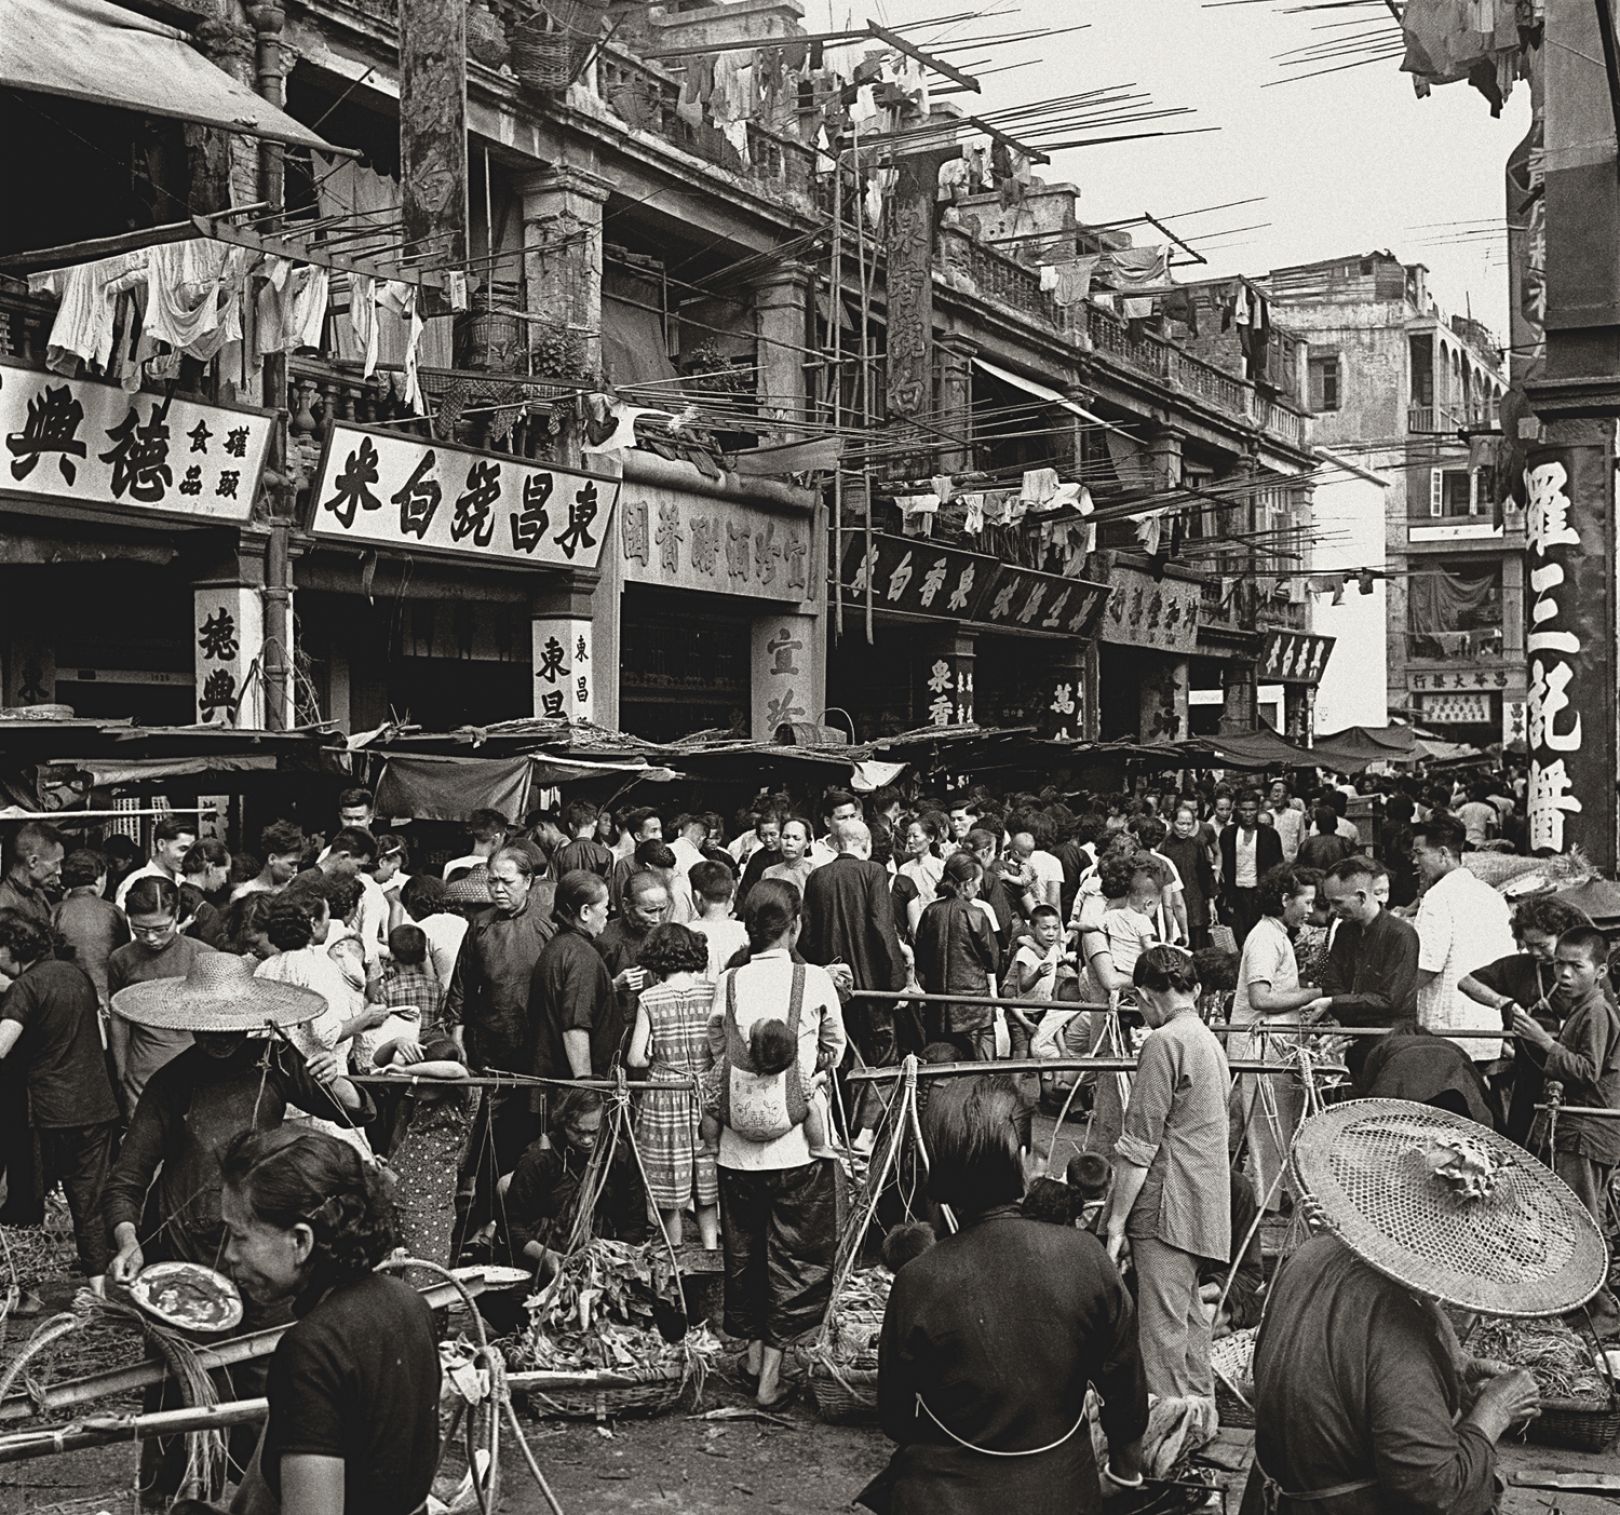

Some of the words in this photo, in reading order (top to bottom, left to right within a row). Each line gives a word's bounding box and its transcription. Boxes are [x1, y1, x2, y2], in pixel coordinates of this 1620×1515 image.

[324, 436, 598, 559] 東昌號白米
[575, 634, 589, 721] 東昌
[927, 659, 955, 725] 泉香
